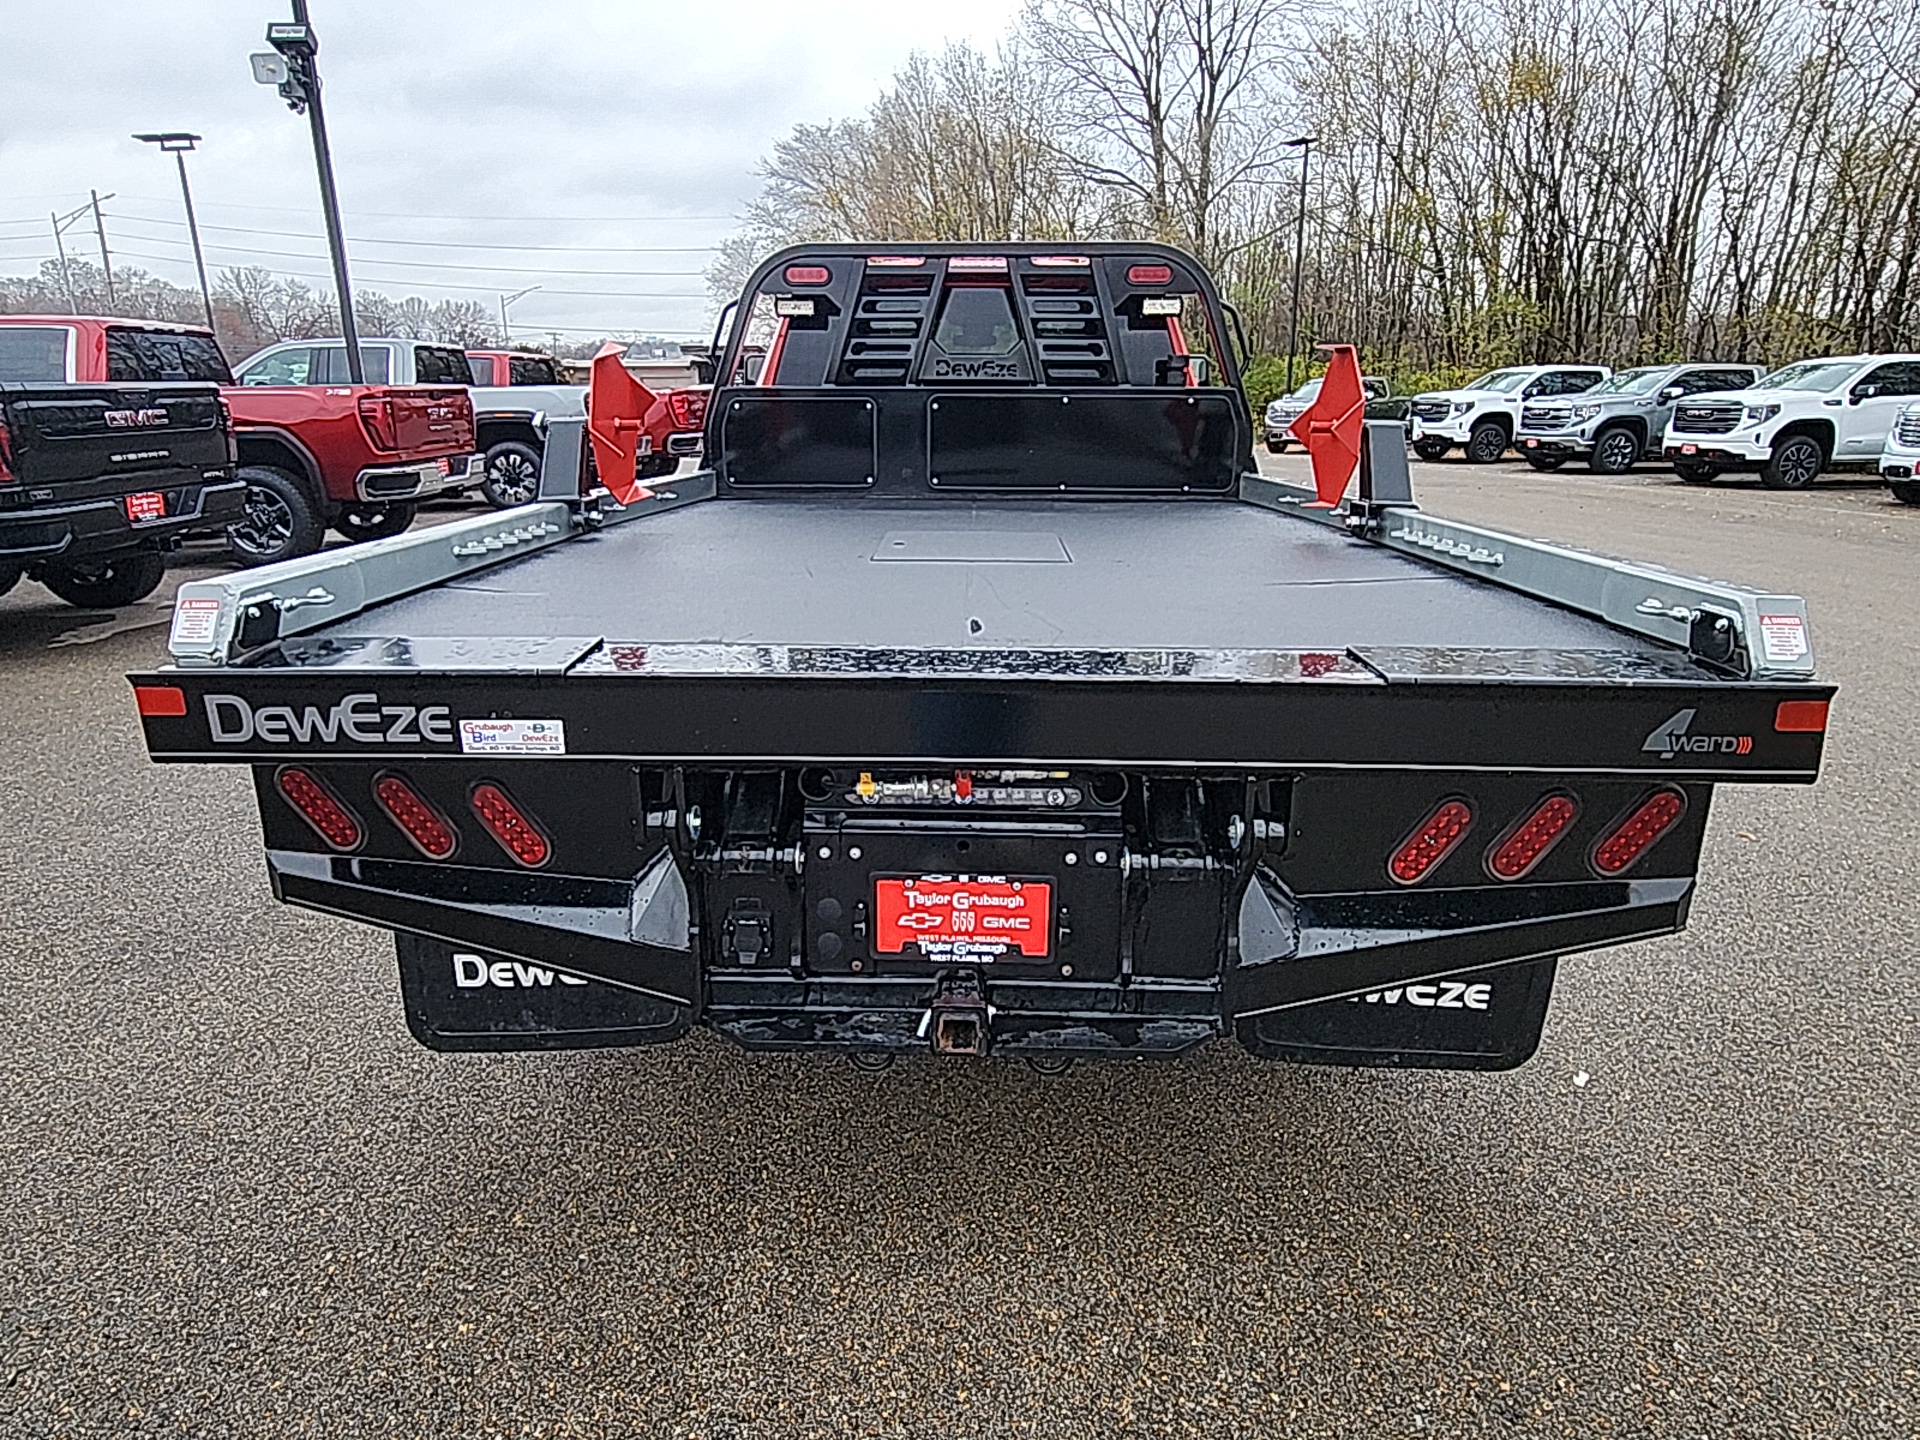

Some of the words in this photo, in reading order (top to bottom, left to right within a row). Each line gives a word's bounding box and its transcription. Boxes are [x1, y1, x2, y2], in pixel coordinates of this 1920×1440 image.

[104, 408, 169, 427] GMC
[203, 693, 454, 743] DewEze
[463, 722, 514, 734] Grubaugh
[472, 732, 497, 743] Bird
[977, 874, 1007, 884] GMC
[903, 891, 951, 909] Taylor
[952, 892, 1025, 910] Grubaugh
[982, 917, 1031, 930] GMC
[917, 940, 952, 955] Taylor
[953, 941, 1008, 956] Grubaugh
